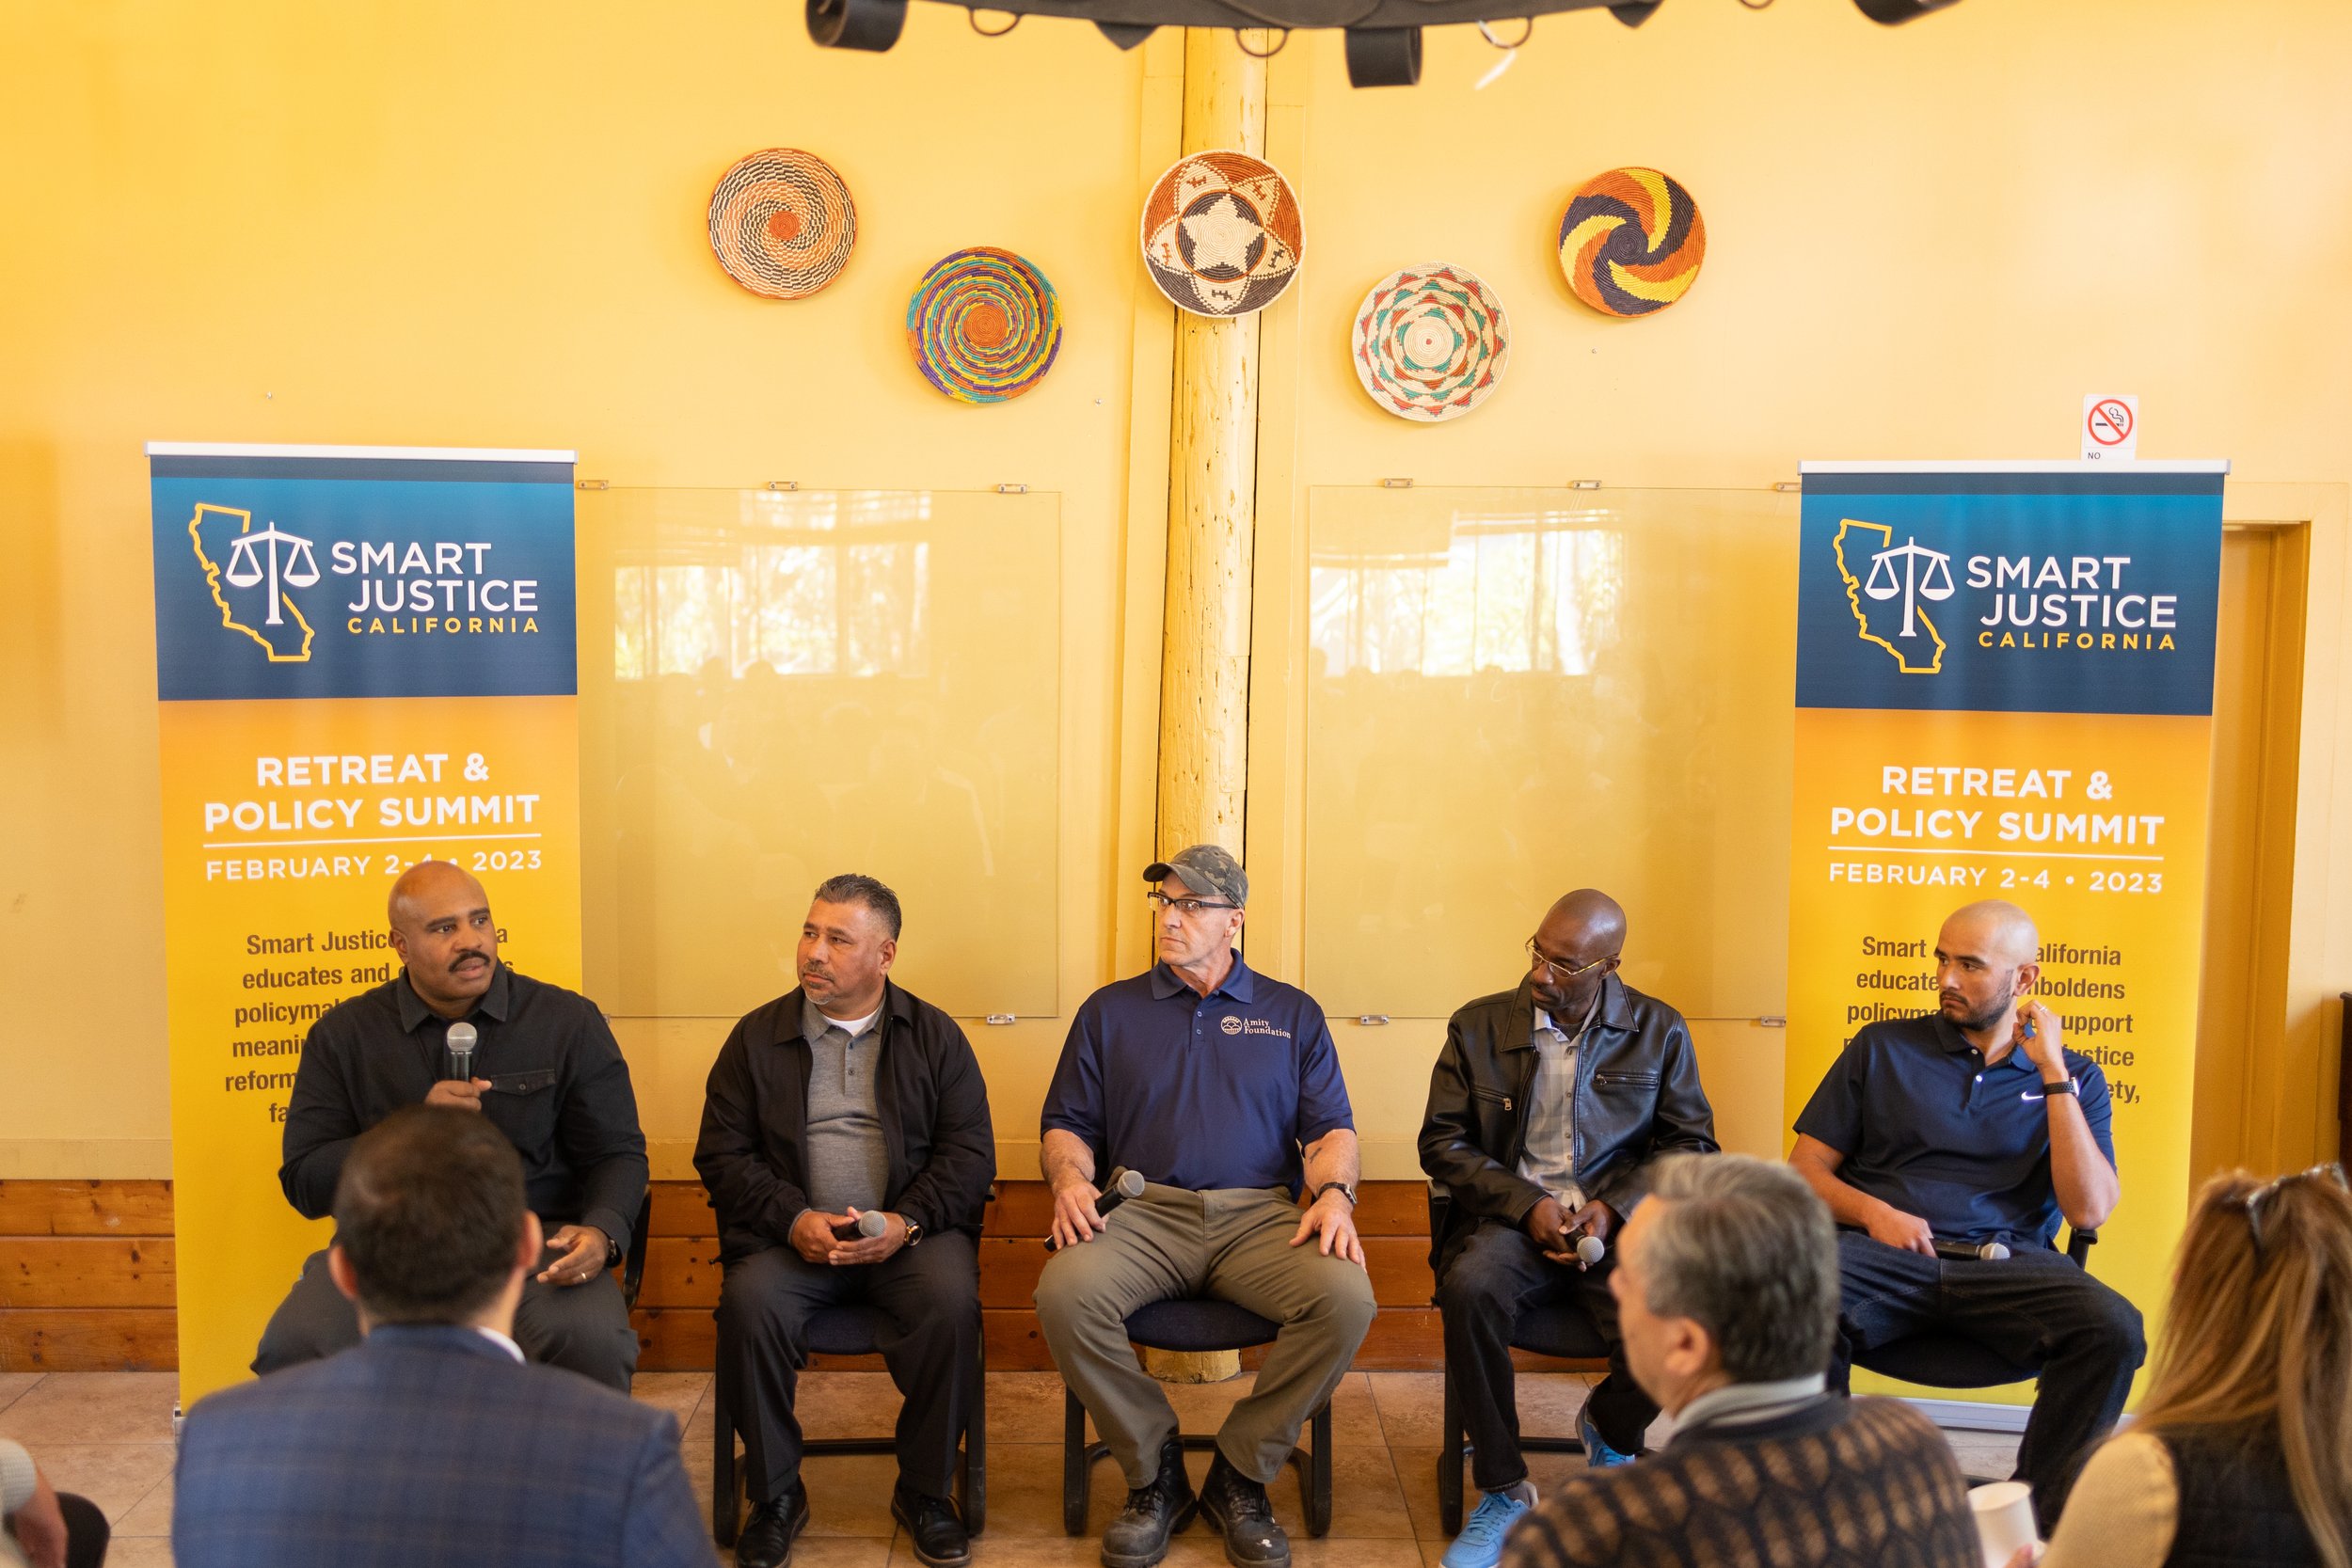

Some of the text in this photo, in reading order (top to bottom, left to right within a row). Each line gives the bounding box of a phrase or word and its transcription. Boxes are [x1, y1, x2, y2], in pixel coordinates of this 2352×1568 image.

[331, 541, 491, 575] SMART
[1966, 555, 2130, 589] SMART
[348, 579, 538, 612] JUSTICE
[348, 617, 538, 634] CALIFORNIA
[1980, 594, 2177, 628] JUSTICE
[1979, 632, 2175, 650] CALIFORNIA
[257, 752, 489, 786] RETREAT &
[1883, 766, 2112, 800] RETREAT &
[205, 794, 539, 832] POLICY SUMMIT
[1831, 807, 2164, 845] POLICY SUMMIT
[206, 855, 372, 881] FEBRUARY
[472, 849, 542, 872] 2023
[1830, 863, 2163, 894] FEBRUARY 2-4 2023
[246, 933, 314, 956] Smart
[1863, 936, 2122, 966] Smart alifornia
[243, 965, 342, 990] educates
[351, 962, 390, 984] and
[1856, 970, 1940, 991] educate
[1243, 1018, 1269, 1028] Amity
[1244, 1026, 1291, 1039] Foundation
[2060, 1014, 2133, 1036] upport
[226, 1070, 297, 1091] reform
